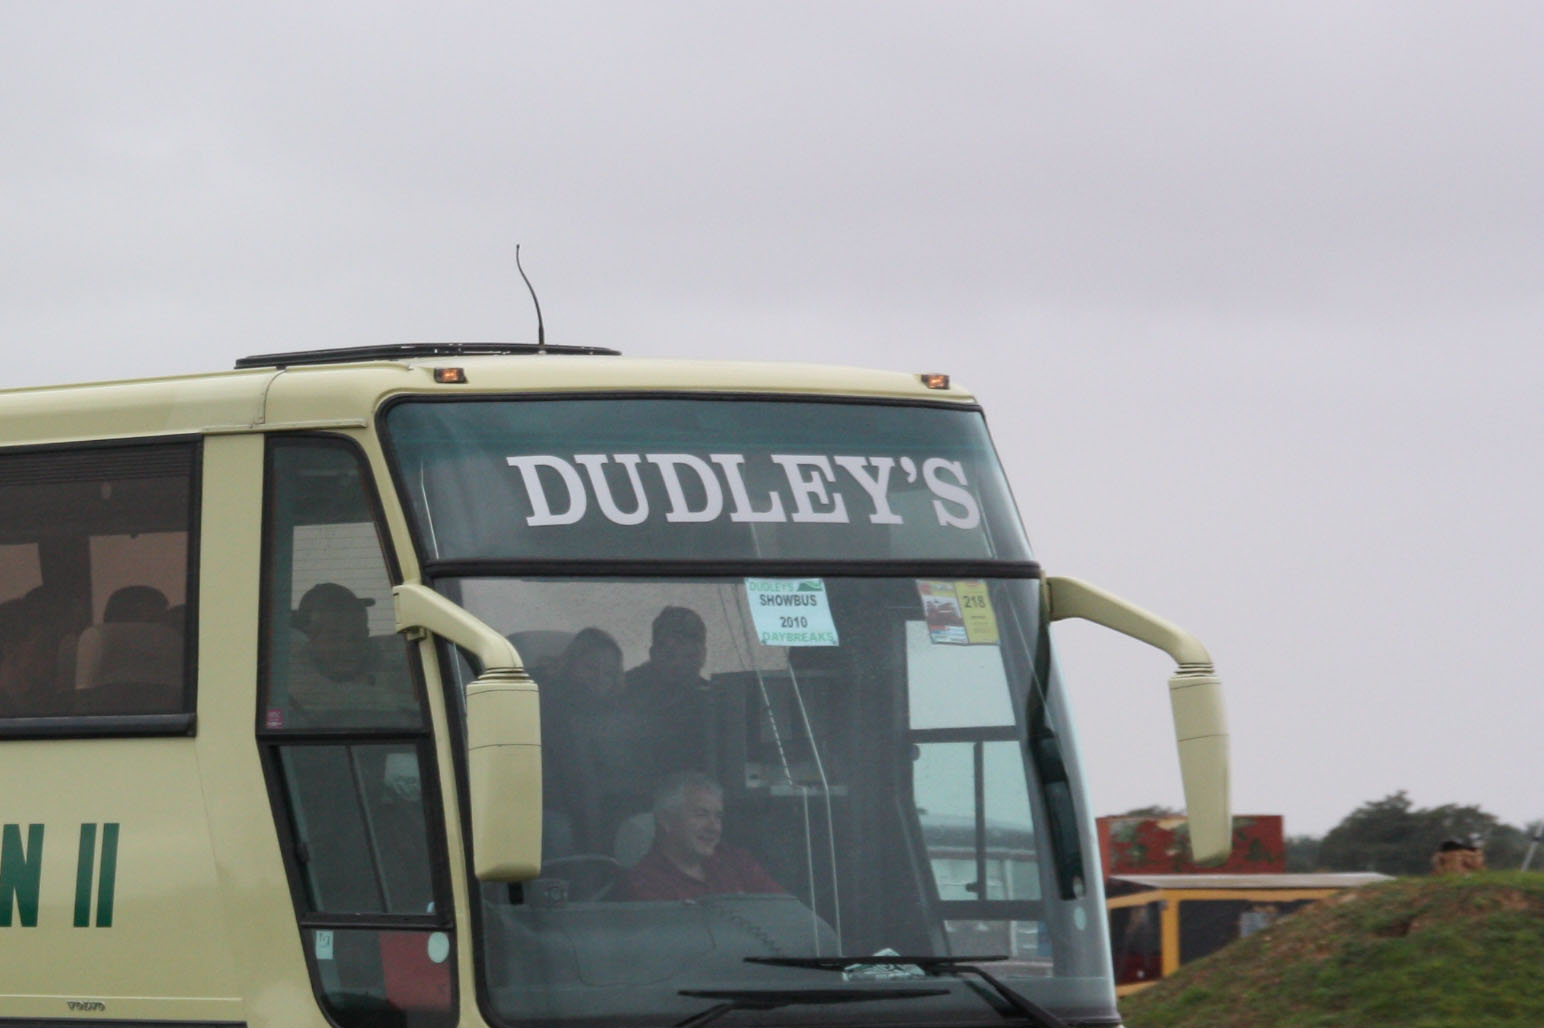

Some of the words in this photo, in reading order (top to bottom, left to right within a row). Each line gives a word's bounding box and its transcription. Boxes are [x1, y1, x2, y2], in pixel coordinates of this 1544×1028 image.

[506, 453, 981, 530] DUDLEY'S
[759, 593, 818, 607] SHOWBUS
[779, 615, 809, 629] 2010
